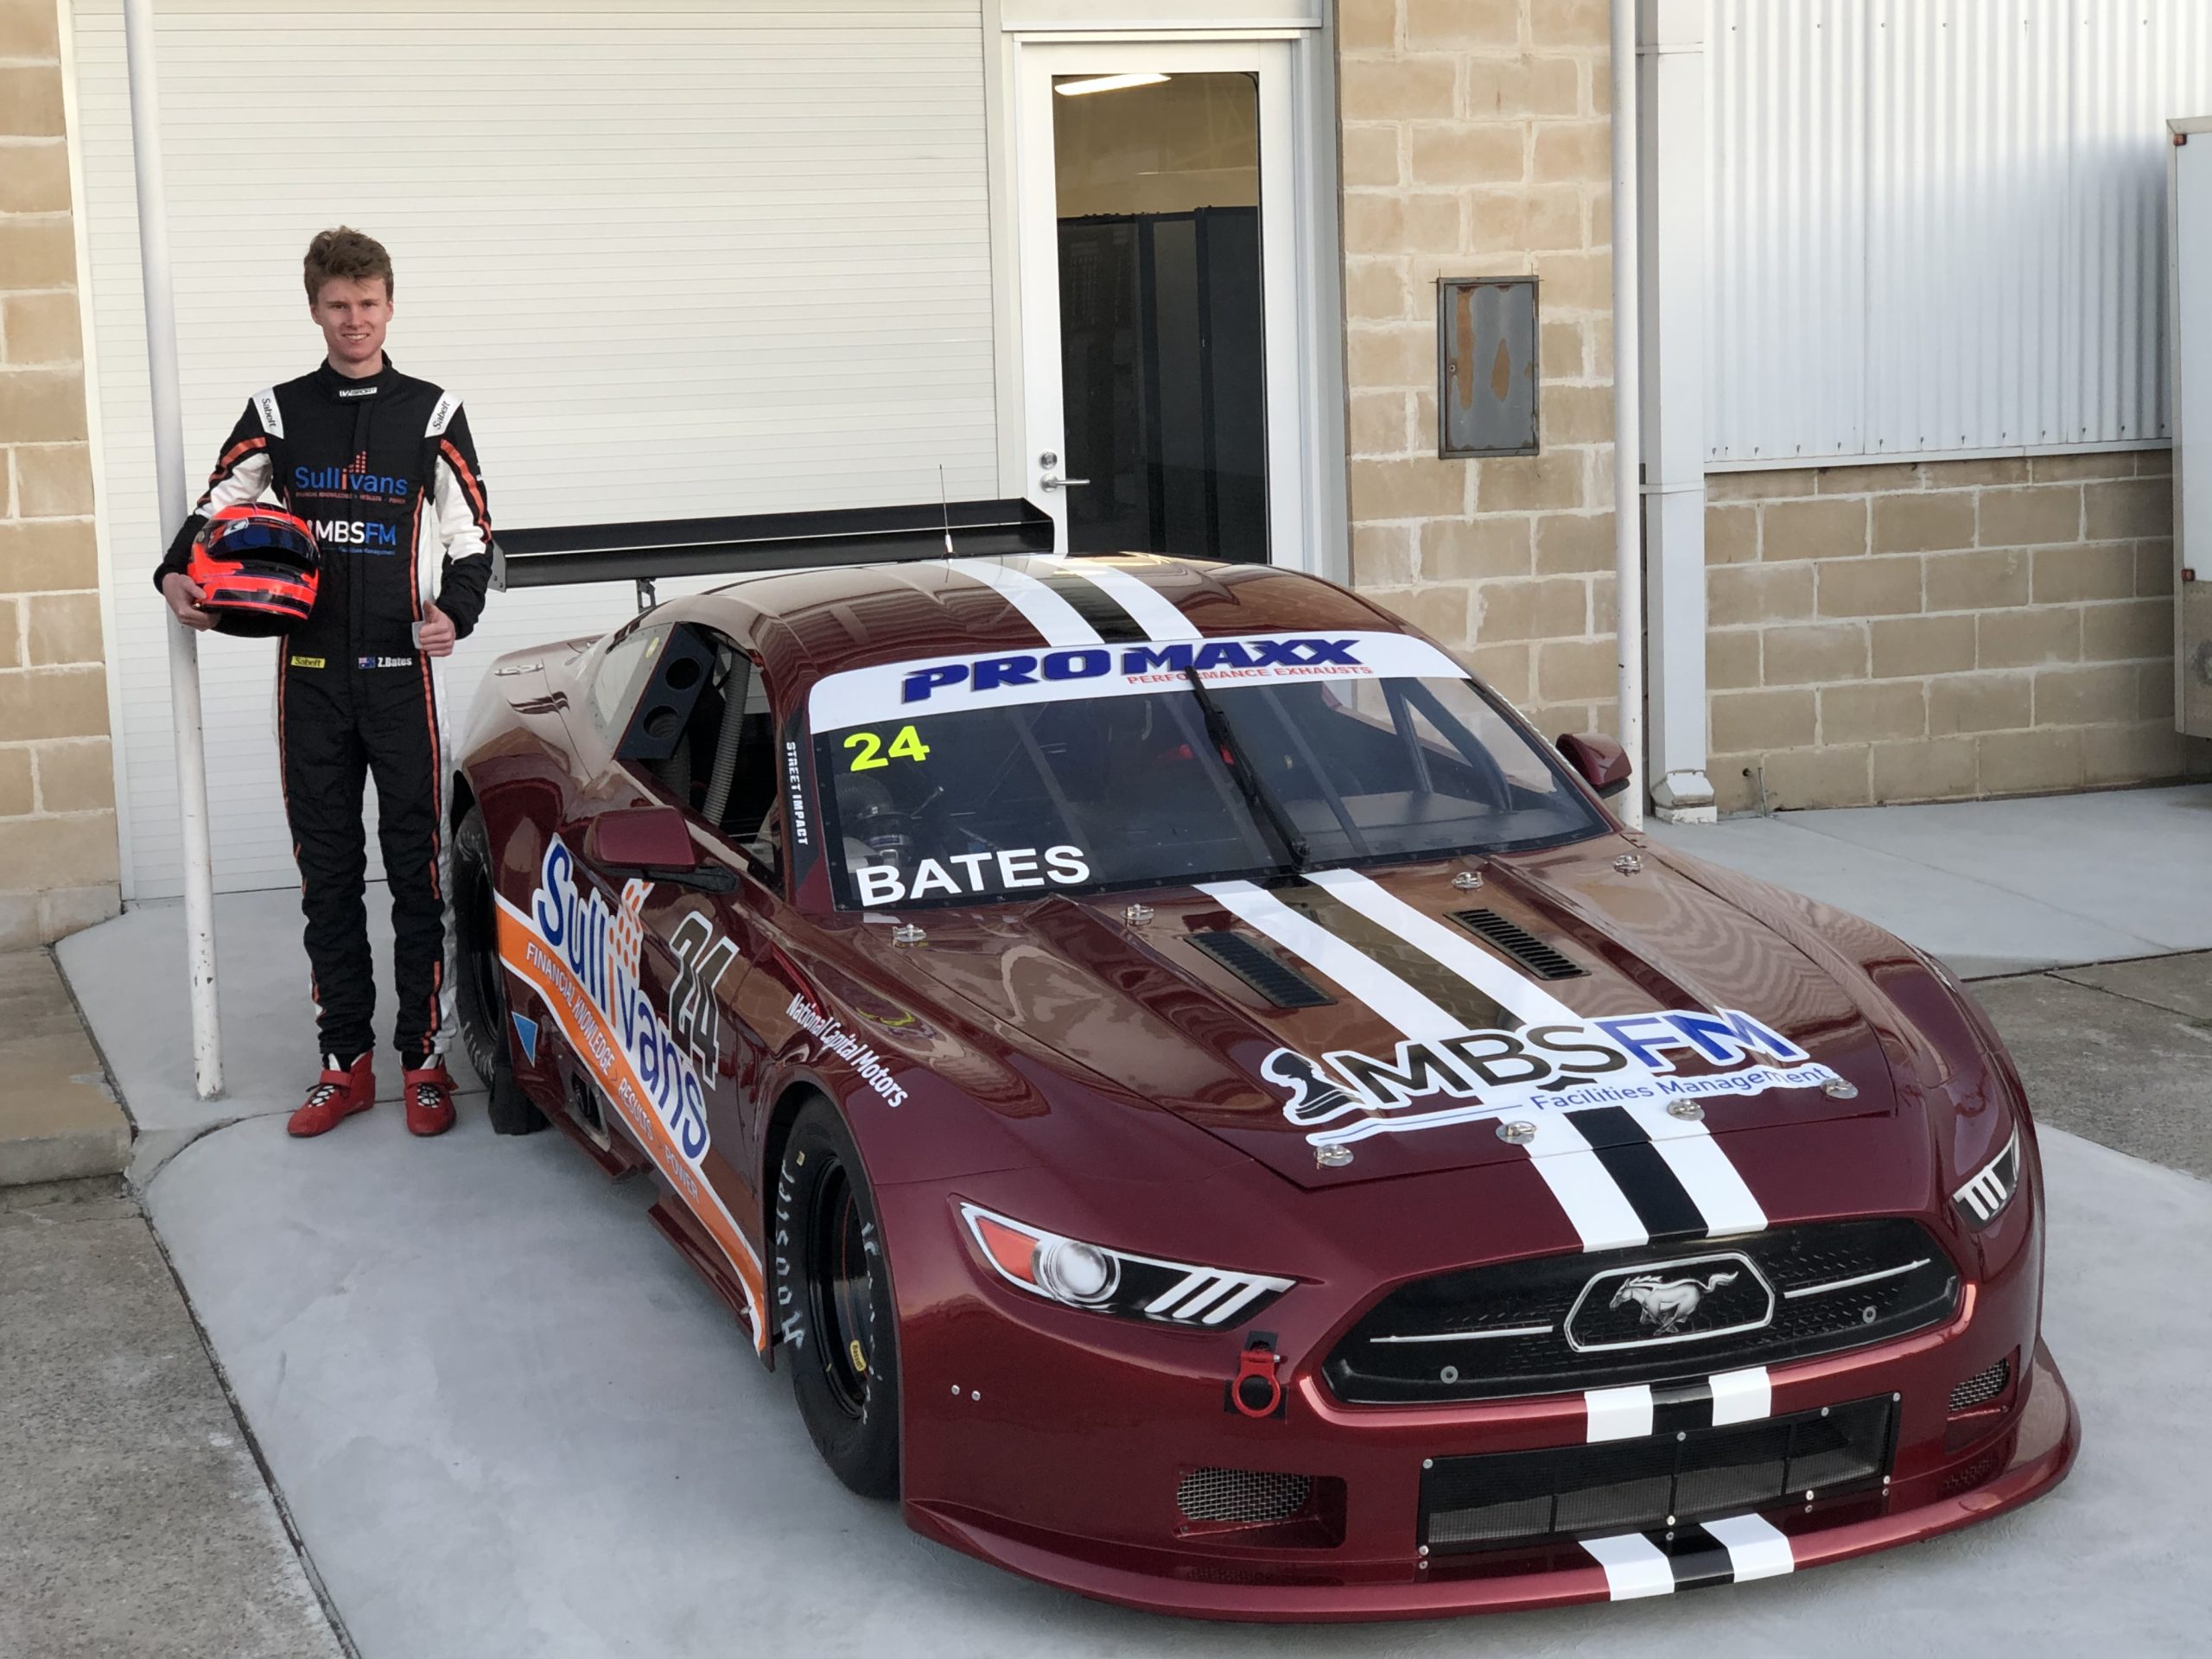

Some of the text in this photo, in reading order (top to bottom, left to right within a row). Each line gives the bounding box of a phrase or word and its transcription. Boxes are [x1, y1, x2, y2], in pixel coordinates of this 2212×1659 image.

[261, 397, 277, 428] Sabelt
[432, 400, 450, 430] Sabelt
[295, 467, 408, 495] Sullivans
[315, 520, 397, 546] MBSFM
[377, 657, 413, 668] Z.Bates
[1127, 665, 1374, 685] PERFOMANCE EXHAUSTS
[842, 725, 930, 772] 24
[785, 741, 809, 845] STREET IMPACT
[855, 844, 1090, 907] BATES
[537, 842, 707, 1160] Sullivans
[669, 910, 740, 1091] 24
[525, 942, 700, 1205] FINANCIAL KNOWLEDGE RESULTS POWER
[785, 992, 909, 1108] National Capital Motors
[1333, 1013, 1801, 1104] MBSFM
[1530, 1067, 1830, 1111] Facilities Management
